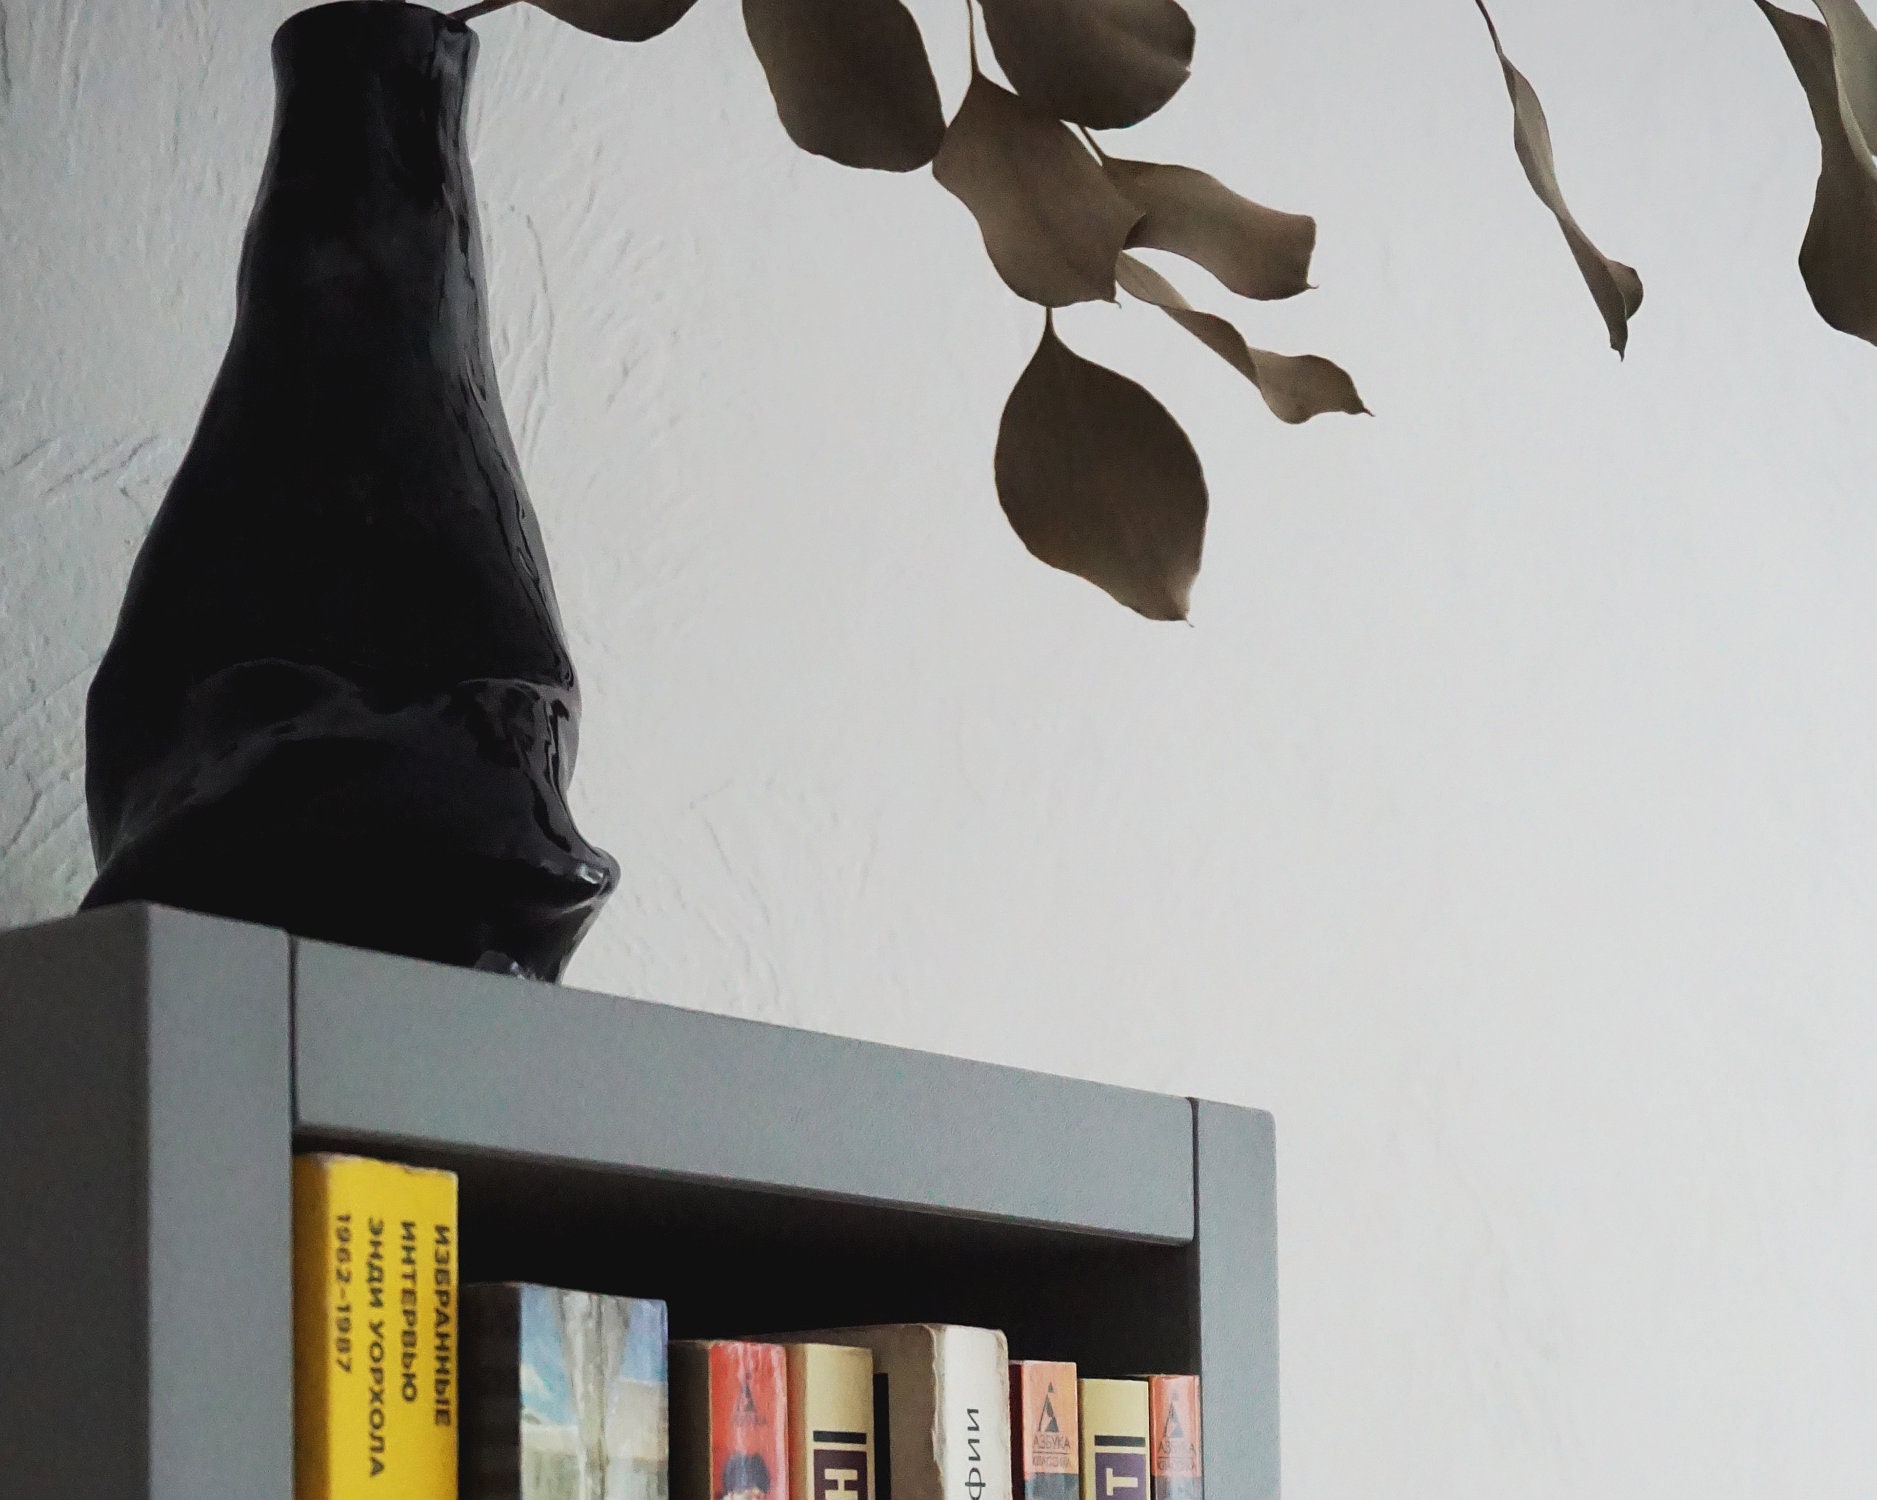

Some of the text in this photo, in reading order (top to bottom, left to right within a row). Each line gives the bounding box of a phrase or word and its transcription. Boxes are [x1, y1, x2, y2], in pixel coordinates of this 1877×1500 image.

[335, 1213, 352, 1374] 1962-1987
[366, 1216, 385, 1477] ЭНДИ УОРХОЛА
[401, 1220, 417, 1403] ИНТЕРВЬЮ
[434, 1224, 451, 1426] ИЗБРАННЫЕ
